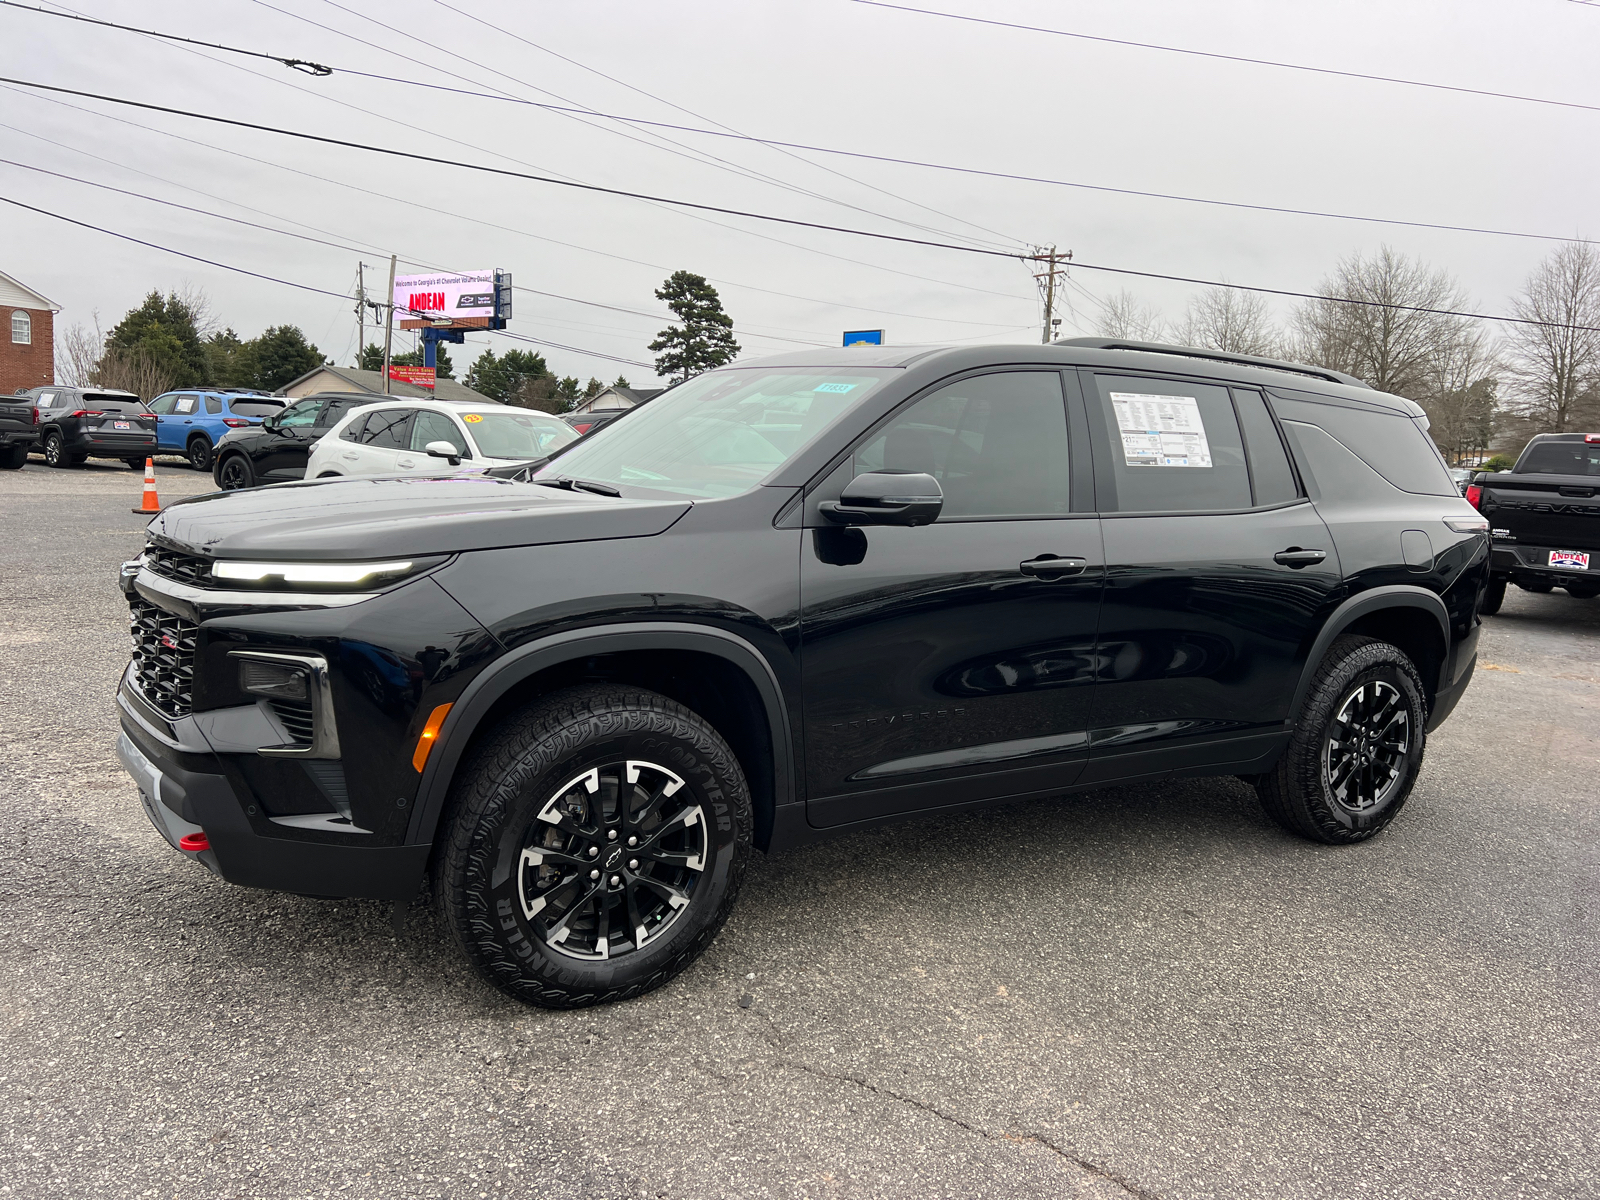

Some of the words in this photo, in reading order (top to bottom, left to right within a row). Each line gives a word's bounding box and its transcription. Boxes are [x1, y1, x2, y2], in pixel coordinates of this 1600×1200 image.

[418, 278, 436, 287] Georgia's
[441, 276, 461, 285] Chevrolet
[409, 292, 445, 311] ANDEAN
[1550, 553, 1588, 565] ANDEAN
[831, 708, 966, 731] TRAVERSE
[640, 736, 734, 834] GOODYEAR
[496, 897, 602, 988] WRANGLER
